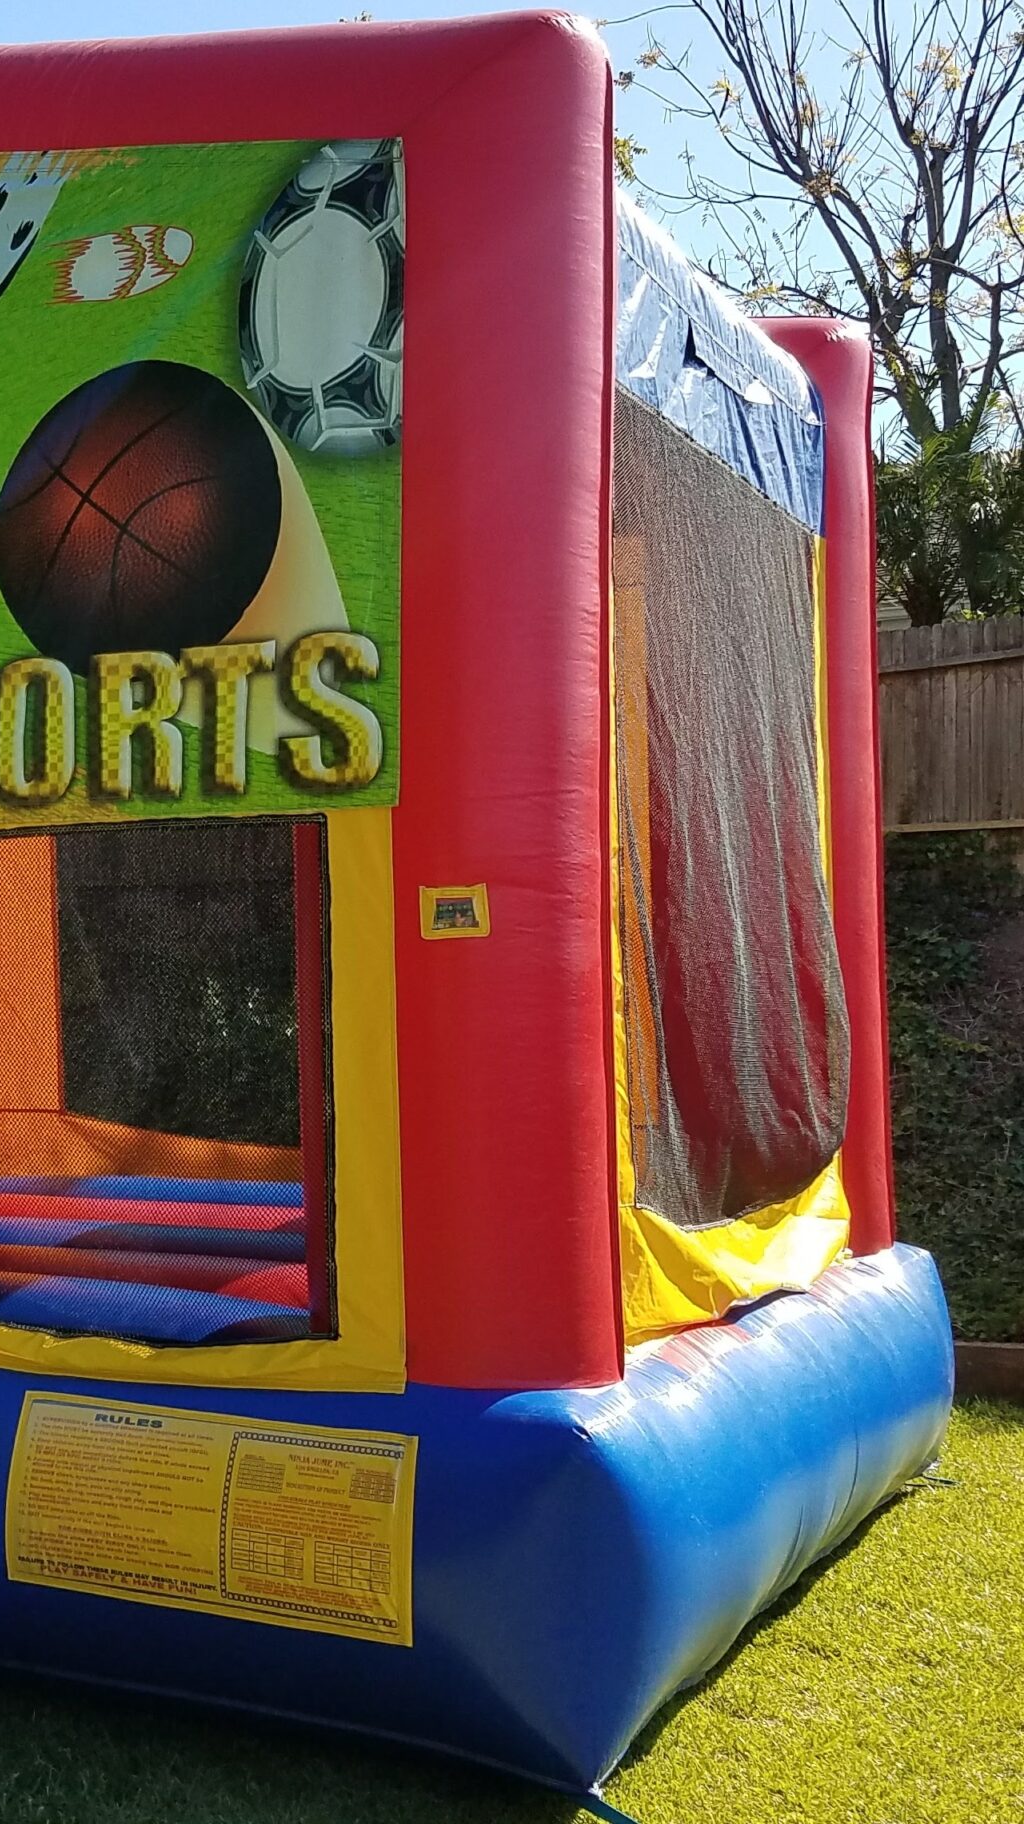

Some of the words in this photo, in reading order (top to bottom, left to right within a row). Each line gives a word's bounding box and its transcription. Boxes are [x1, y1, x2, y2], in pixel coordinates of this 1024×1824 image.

[94, 1413, 164, 1428] RULES
[40, 1565, 68, 1575] PLAY
[73, 1569, 116, 1582] SAFELY
[133, 1578, 164, 1589] HAVE
[168, 1583, 197, 1595] FUN!
[87, 1565, 109, 1574] THESE
[151, 1575, 178, 1584] RESULT
